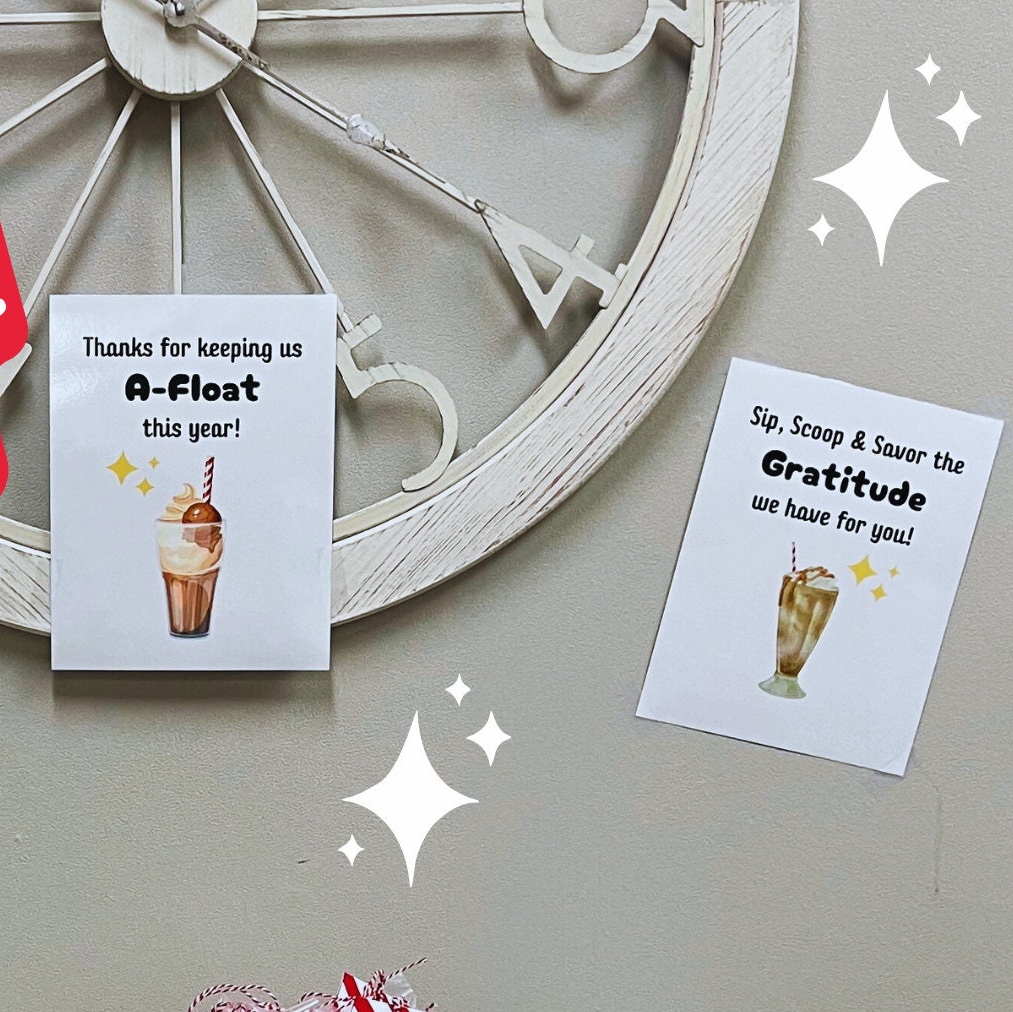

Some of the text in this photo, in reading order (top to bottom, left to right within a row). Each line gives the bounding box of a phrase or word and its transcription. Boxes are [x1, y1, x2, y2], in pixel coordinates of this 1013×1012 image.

[474, 198, 628, 329] 4
[83, 336, 303, 363] Thanks for keeping us
[125, 373, 260, 402] A-Float
[143, 417, 240, 443] this year!
[749, 405, 965, 474] Sip, Scoop & Savor the
[762, 450, 927, 512] Gratitude
[752, 494, 915, 545] we have for you!
